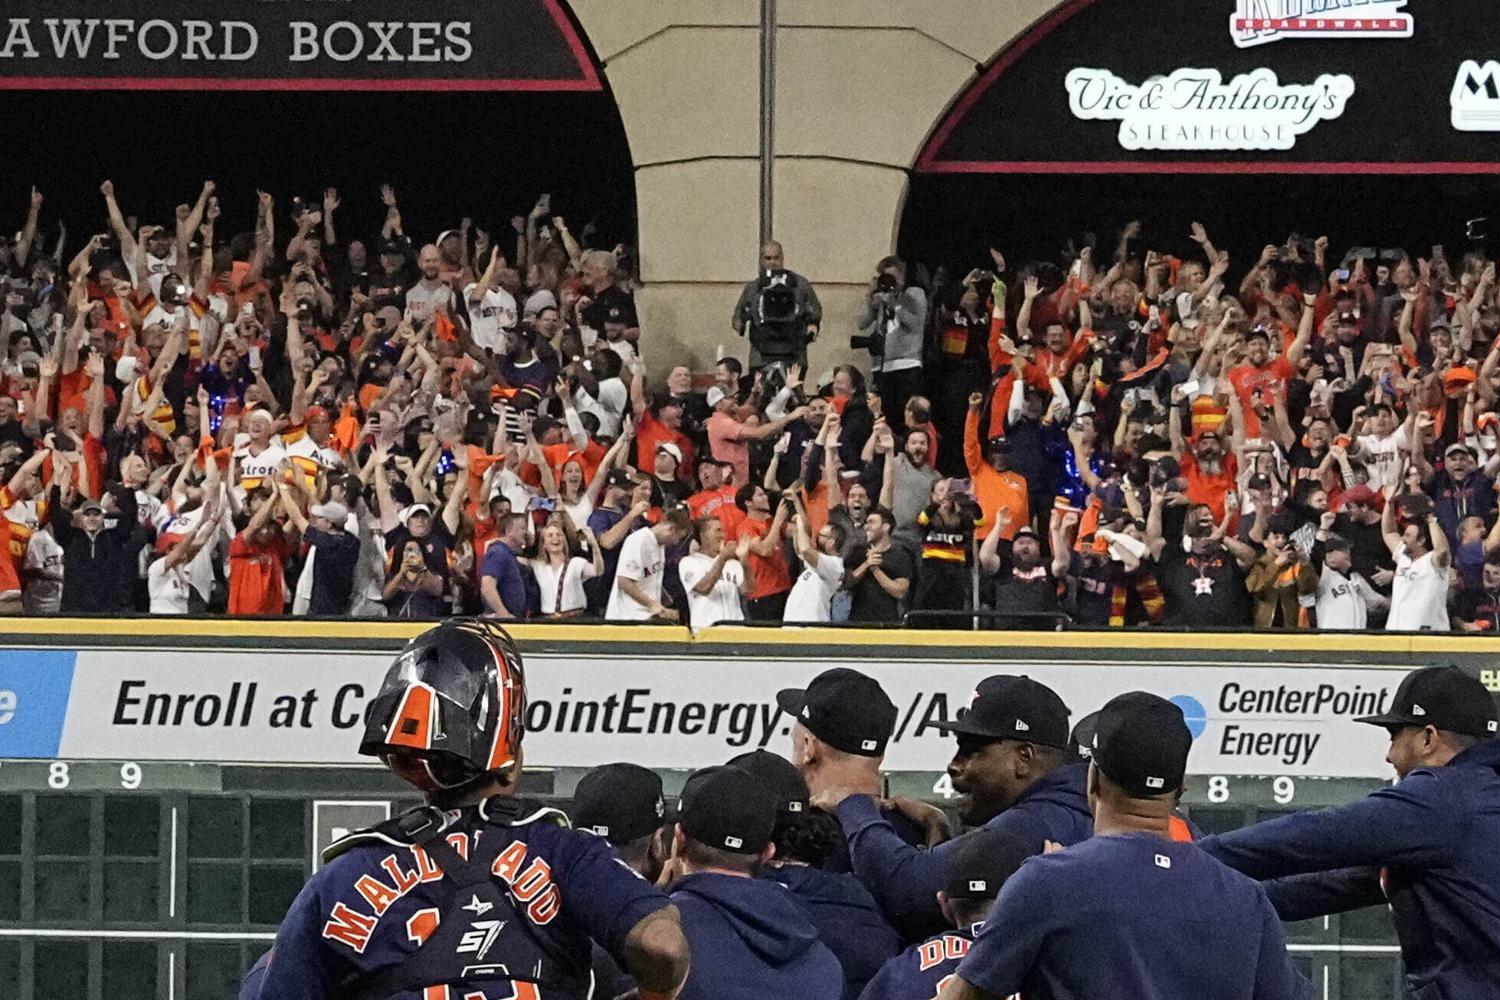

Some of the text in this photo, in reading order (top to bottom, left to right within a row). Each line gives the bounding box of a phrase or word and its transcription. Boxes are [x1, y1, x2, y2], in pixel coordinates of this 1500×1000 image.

[0, 18, 473, 62] AWFORD BOXES
[1244, 18, 1400, 29] BOARDWALK
[1074, 76, 1337, 126] Vic & Anthony's
[1128, 123, 1287, 142] STEAKHOUSE
[112, 680, 257, 726] Enroll
[269, 688, 318, 728] at
[1218, 681, 1389, 715] CenterPoint
[1219, 725, 1321, 765] Energy
[48, 762, 143, 789] 8 9
[933, 773, 955, 799] 4
[1207, 777, 1295, 803] 8 9
[322, 831, 562, 955] MALDADO
